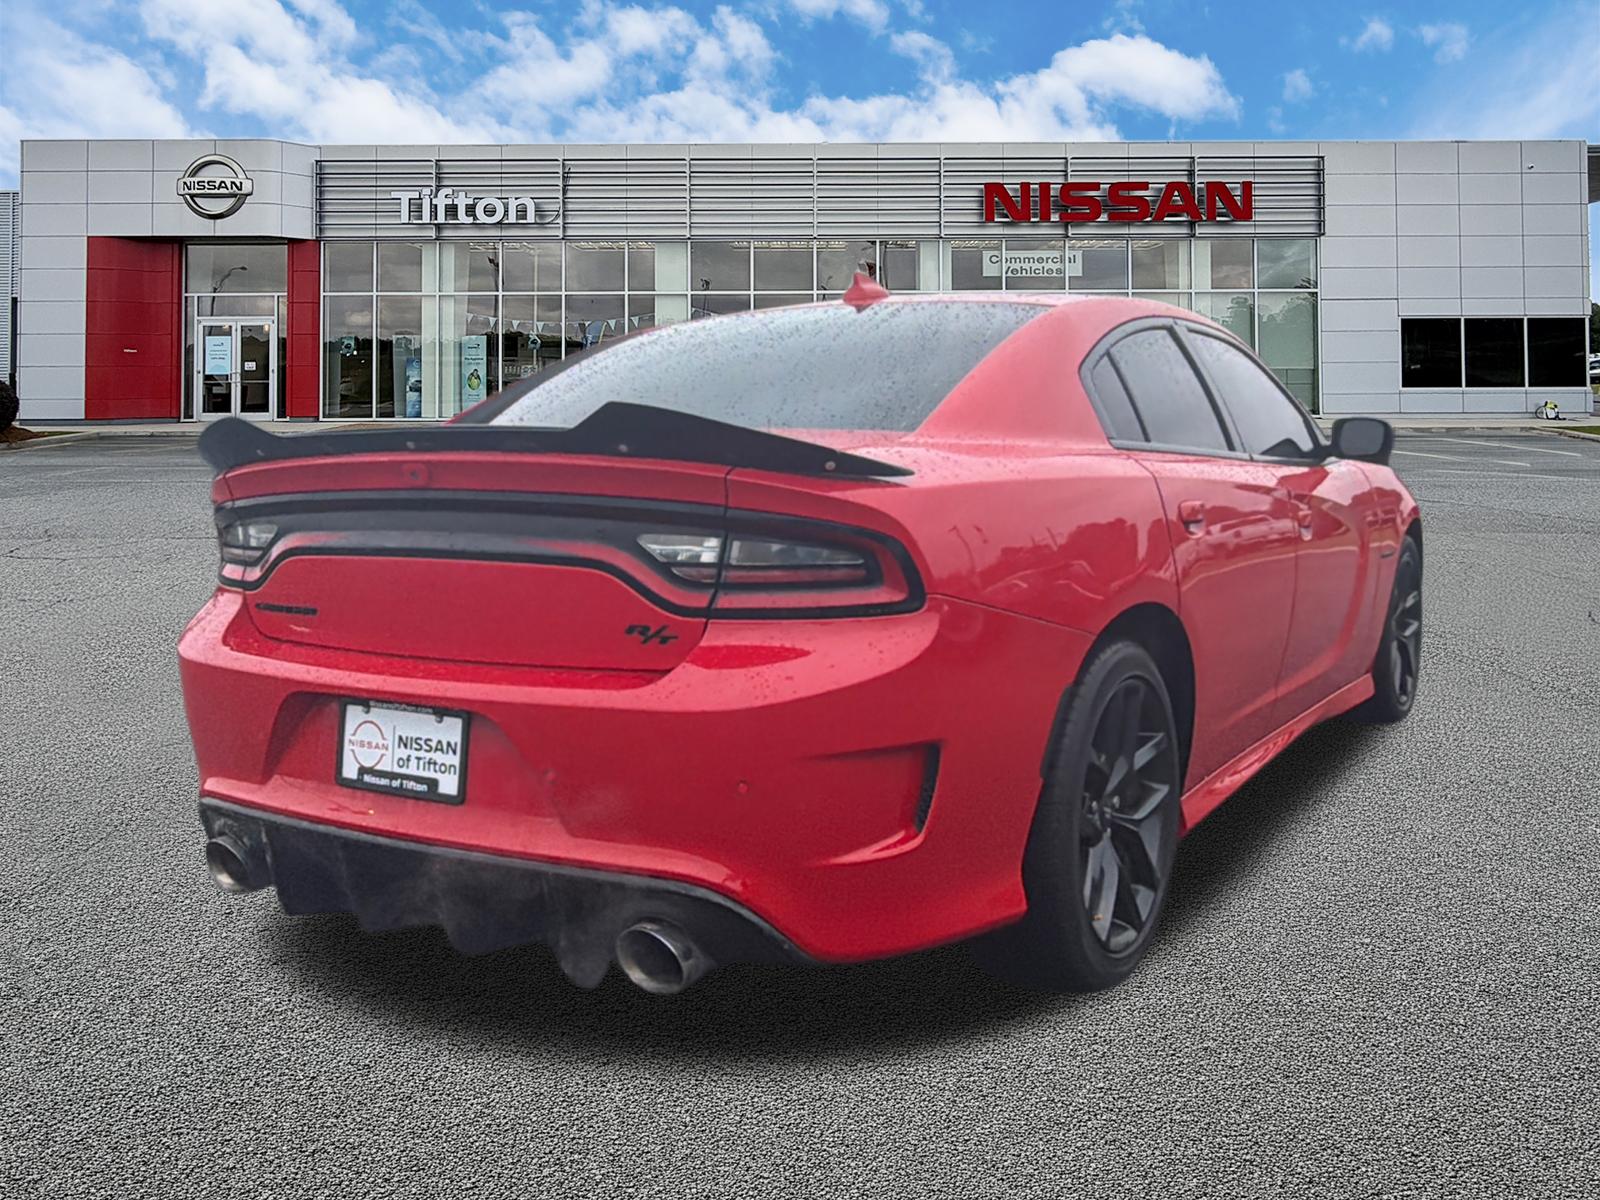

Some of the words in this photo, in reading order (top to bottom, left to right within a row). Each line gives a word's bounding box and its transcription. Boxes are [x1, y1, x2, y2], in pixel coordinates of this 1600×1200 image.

[182, 180, 243, 192] NISSAN
[391, 187, 536, 224] Tifton
[983, 181, 1253, 222] NISSAN
[625, 624, 679, 646] R/T
[348, 739, 389, 751] NISSAN
[397, 735, 458, 756] NISSAN
[397, 755, 412, 769] of
[414, 757, 457, 775] Tifton
[363, 774, 390, 787] Nissan
[391, 778, 402, 788] of
[402, 780, 428, 792] Tifton
